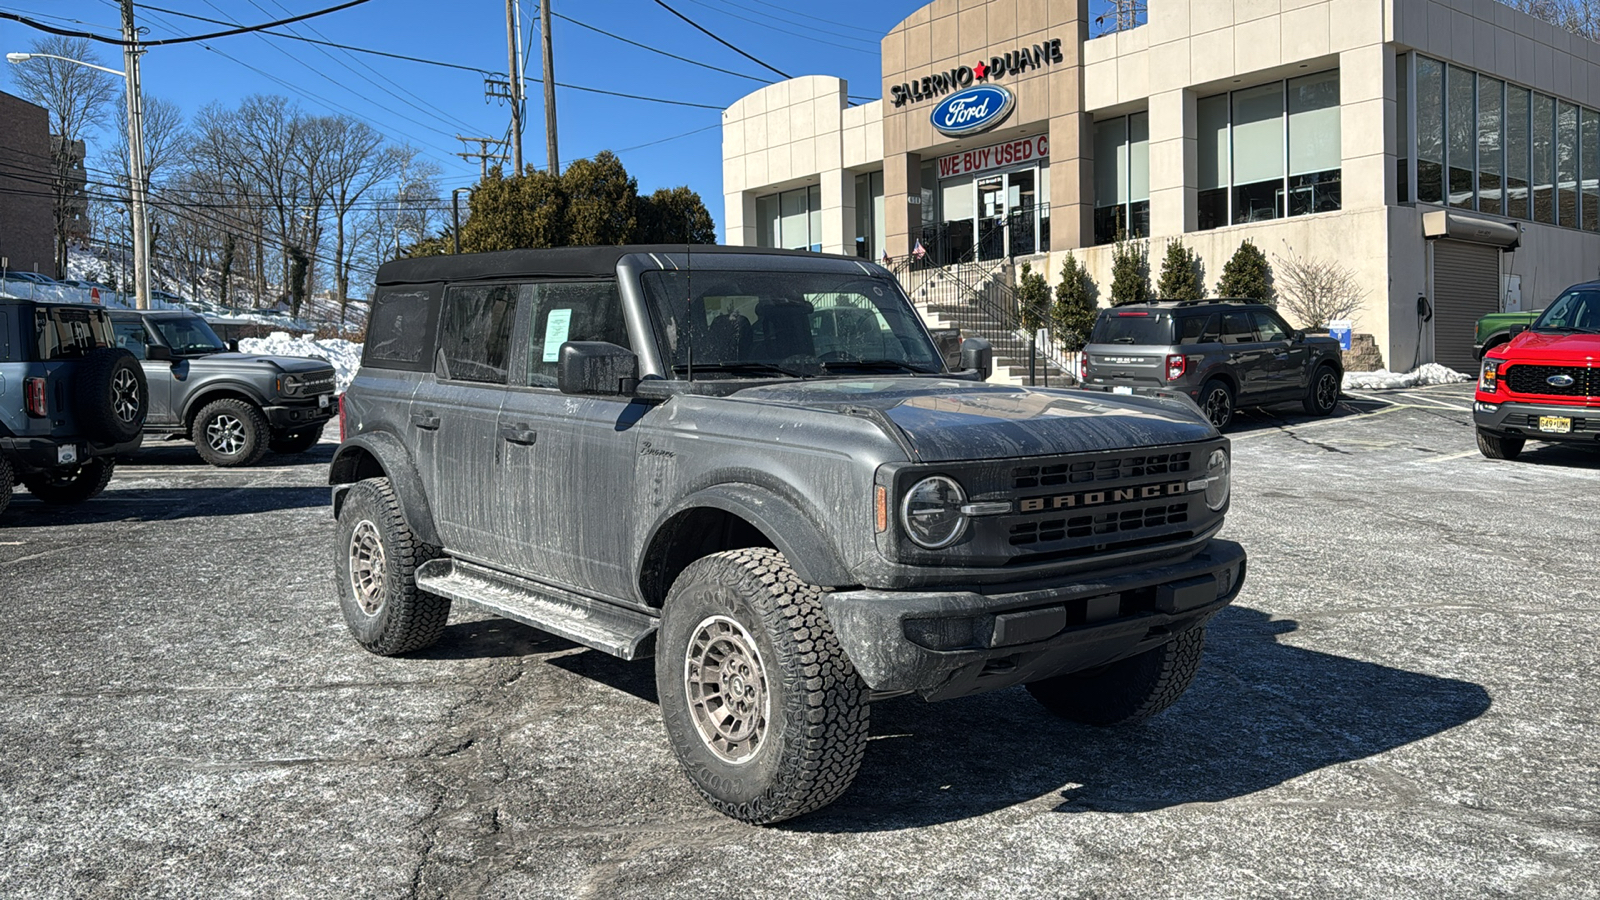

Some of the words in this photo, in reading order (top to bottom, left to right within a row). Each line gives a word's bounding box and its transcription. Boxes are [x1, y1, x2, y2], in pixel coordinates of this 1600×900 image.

[890, 66, 972, 104] SALERNO
[990, 38, 1062, 77] DUANE
[945, 95, 990, 126] Ford
[939, 155, 960, 177] WE
[964, 148, 991, 172] BUY
[994, 139, 1033, 166] USED
[1037, 135, 1049, 157] C
[1020, 482, 1185, 512] BRONCO
